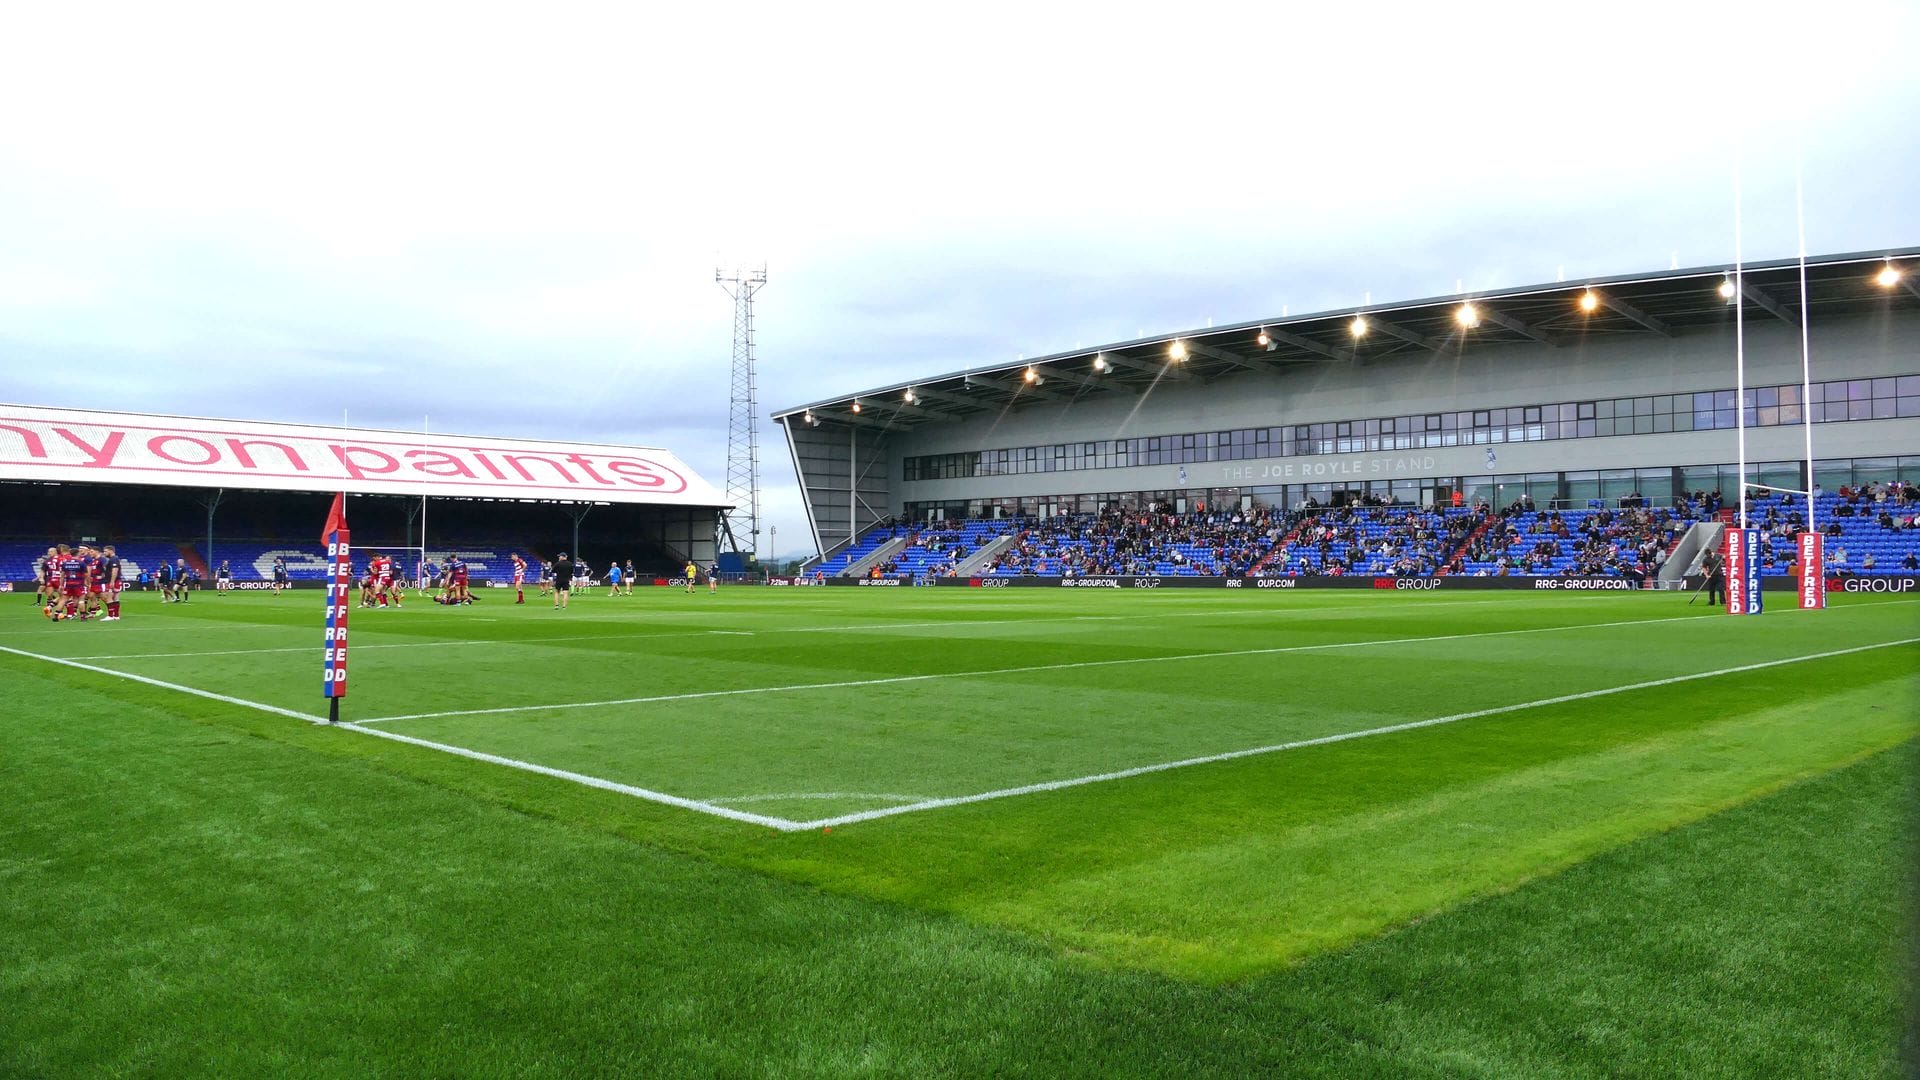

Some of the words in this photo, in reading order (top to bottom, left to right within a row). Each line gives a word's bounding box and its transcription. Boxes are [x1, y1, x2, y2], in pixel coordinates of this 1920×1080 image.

[328, 444, 665, 487] paints
[1222, 466, 1253, 481] THE
[1261, 464, 1294, 478] JOE
[1302, 461, 1362, 476] ROYLE
[1371, 456, 1435, 472] STAND
[1729, 532, 1741, 614] BETFRED
[1748, 532, 1760, 613] BETFRED
[1803, 535, 1816, 608] BETFRED
[1844, 578, 1915, 592] GROUP
[324, 543, 337, 682] BETFRED
[335, 543, 350, 682] BETFRED
